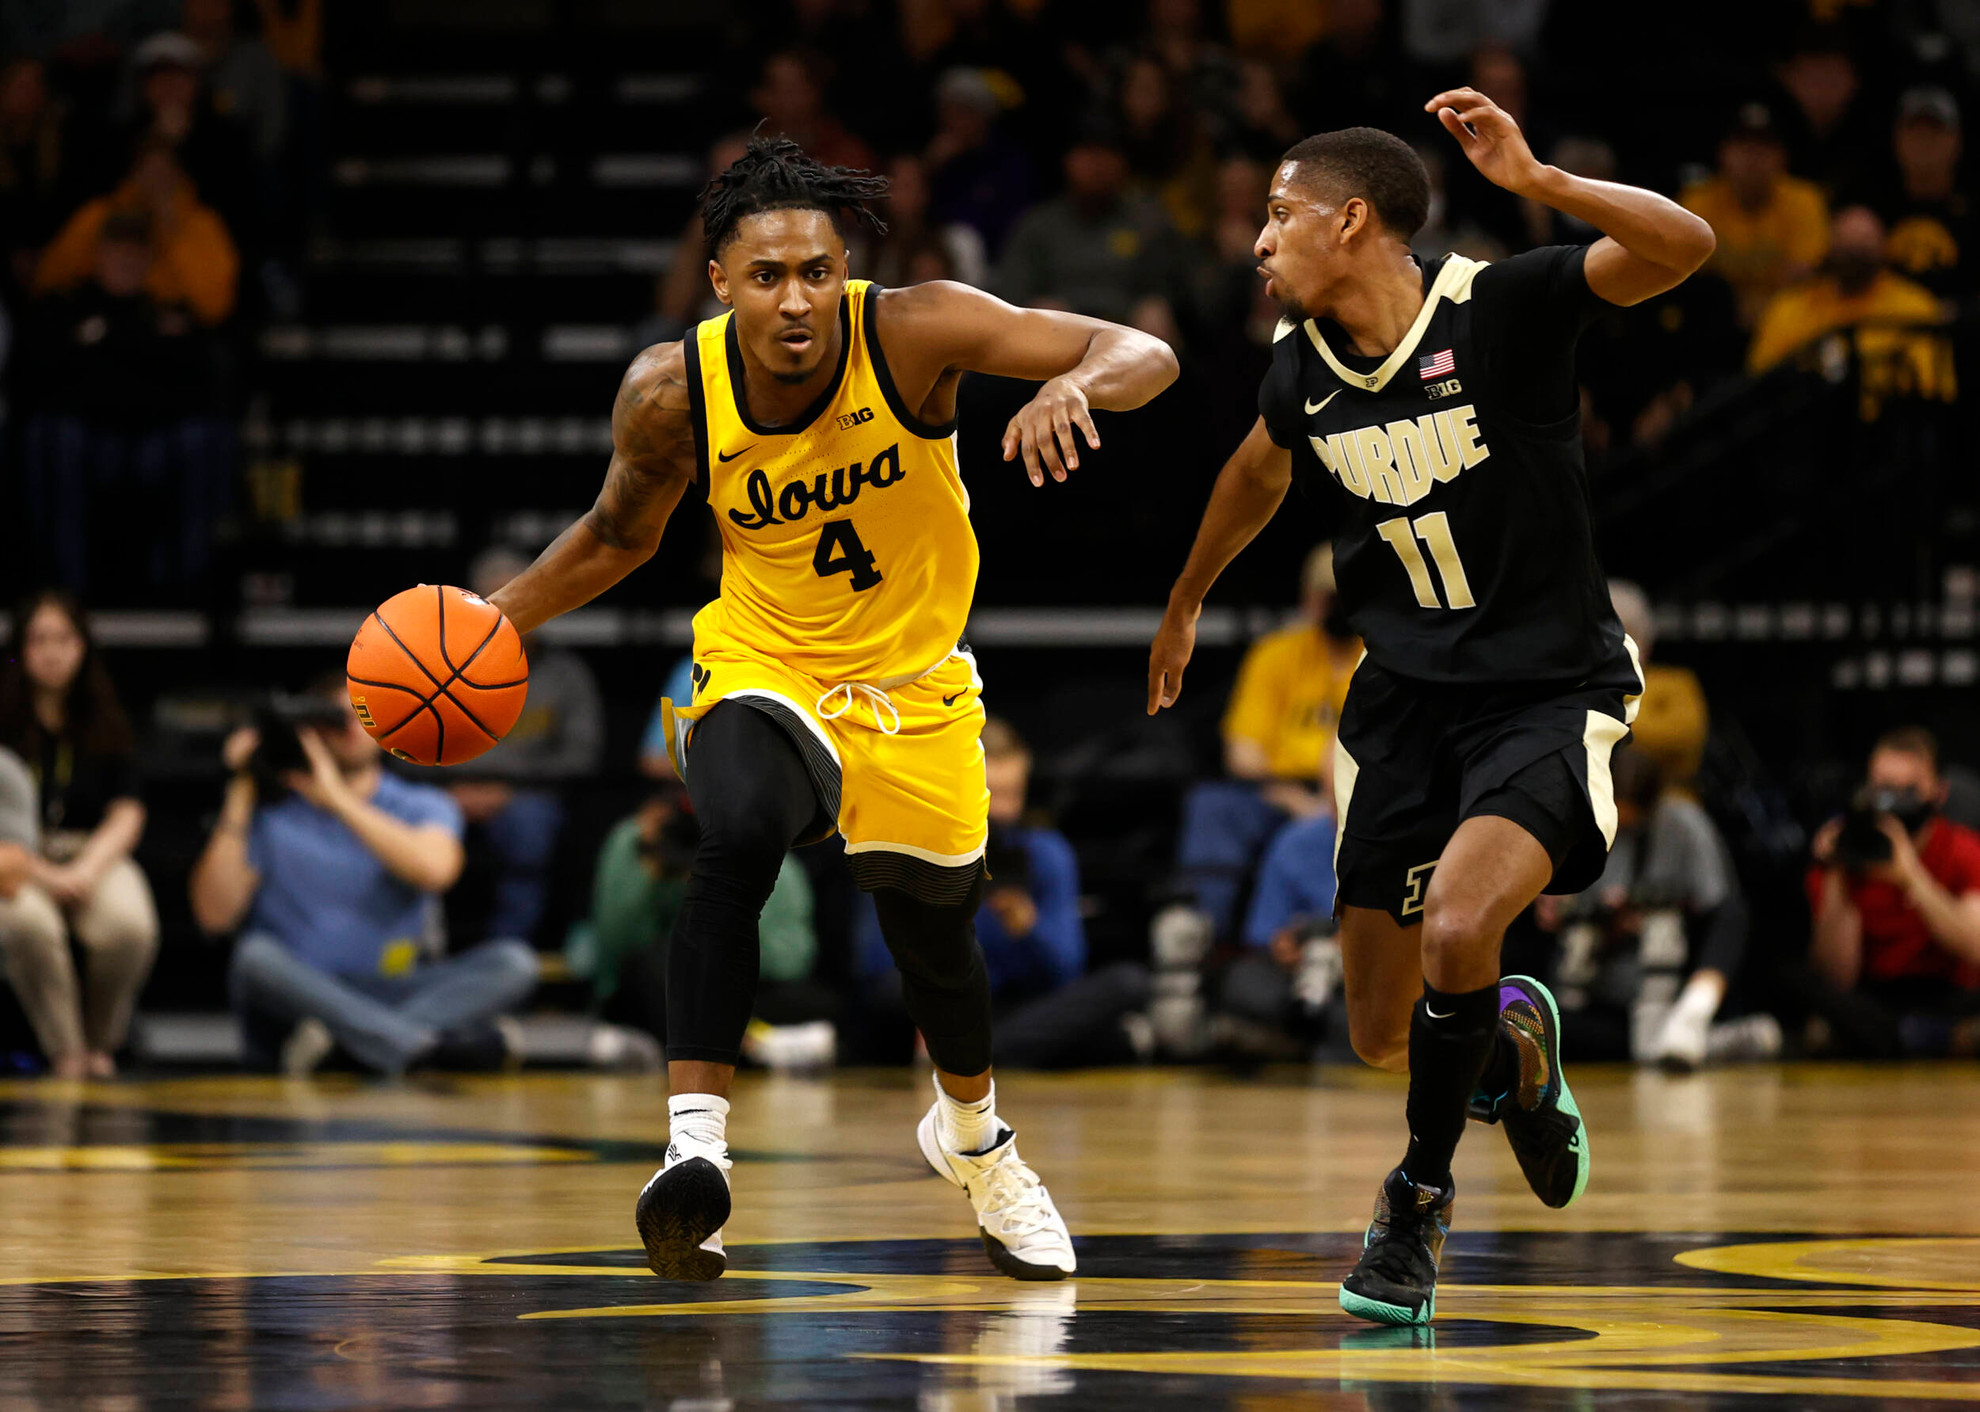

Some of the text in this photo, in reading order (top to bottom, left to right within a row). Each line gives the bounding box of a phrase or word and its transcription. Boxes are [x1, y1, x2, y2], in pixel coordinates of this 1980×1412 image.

[729, 443, 906, 530] Iowa
[1308, 404, 1491, 507] PURDUE
[813, 519, 883, 592] 4
[1375, 511, 1477, 610] 11
